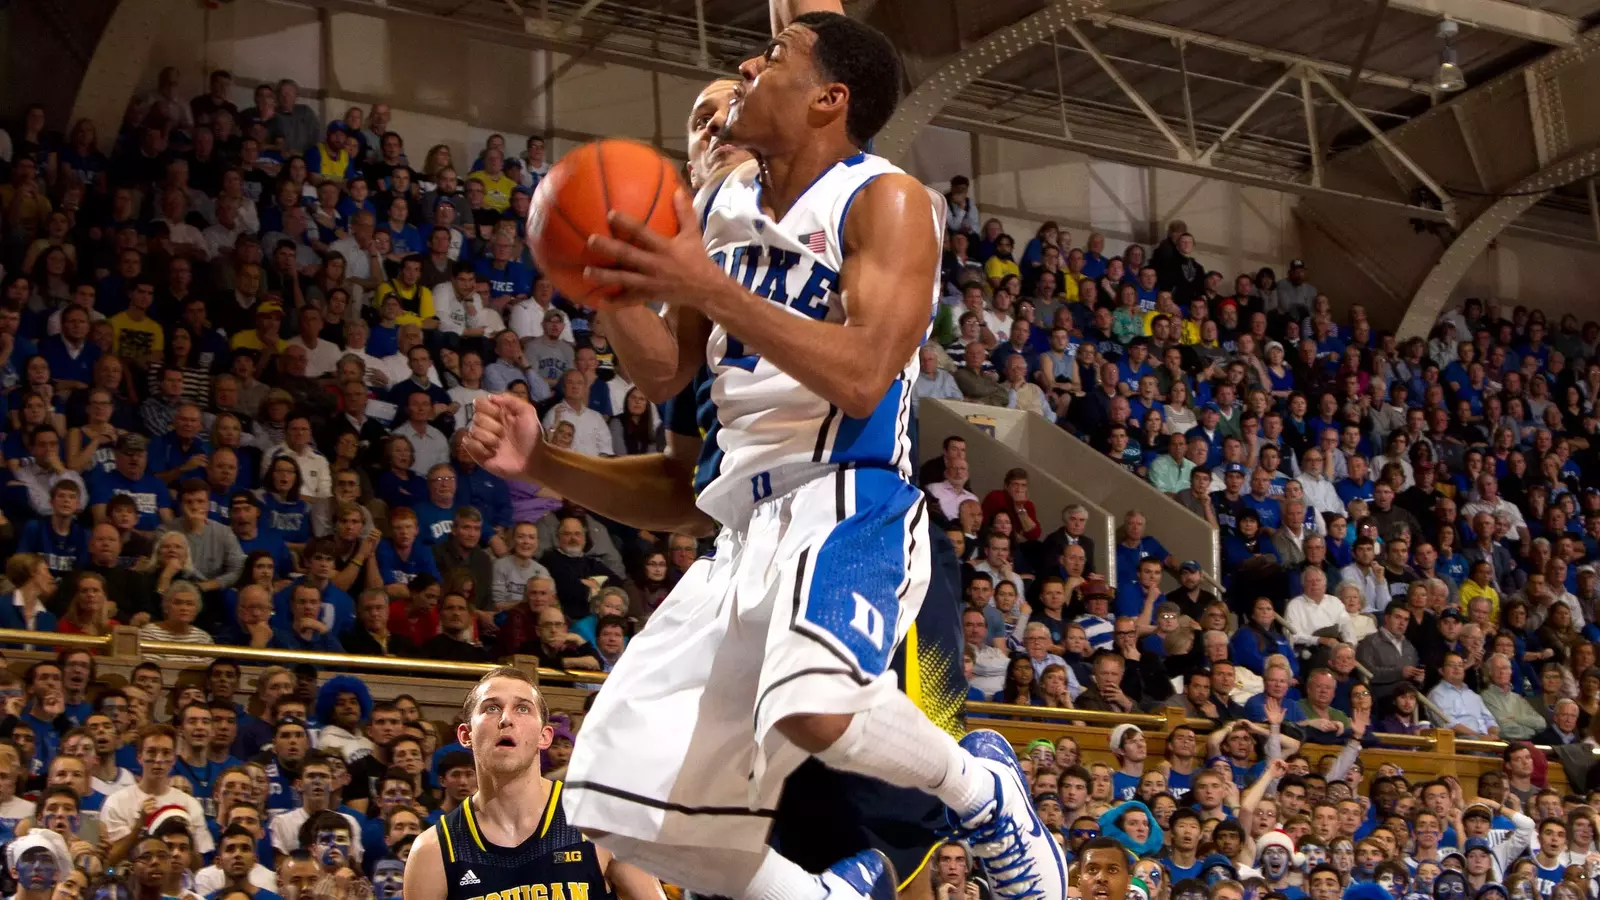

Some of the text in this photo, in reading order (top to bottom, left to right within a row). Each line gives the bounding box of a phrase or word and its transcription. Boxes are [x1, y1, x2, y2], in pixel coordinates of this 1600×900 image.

[751, 472, 772, 503] D
[430, 520, 452, 538] DU
[849, 592, 884, 651] D
[460, 878, 481, 886] adidas
